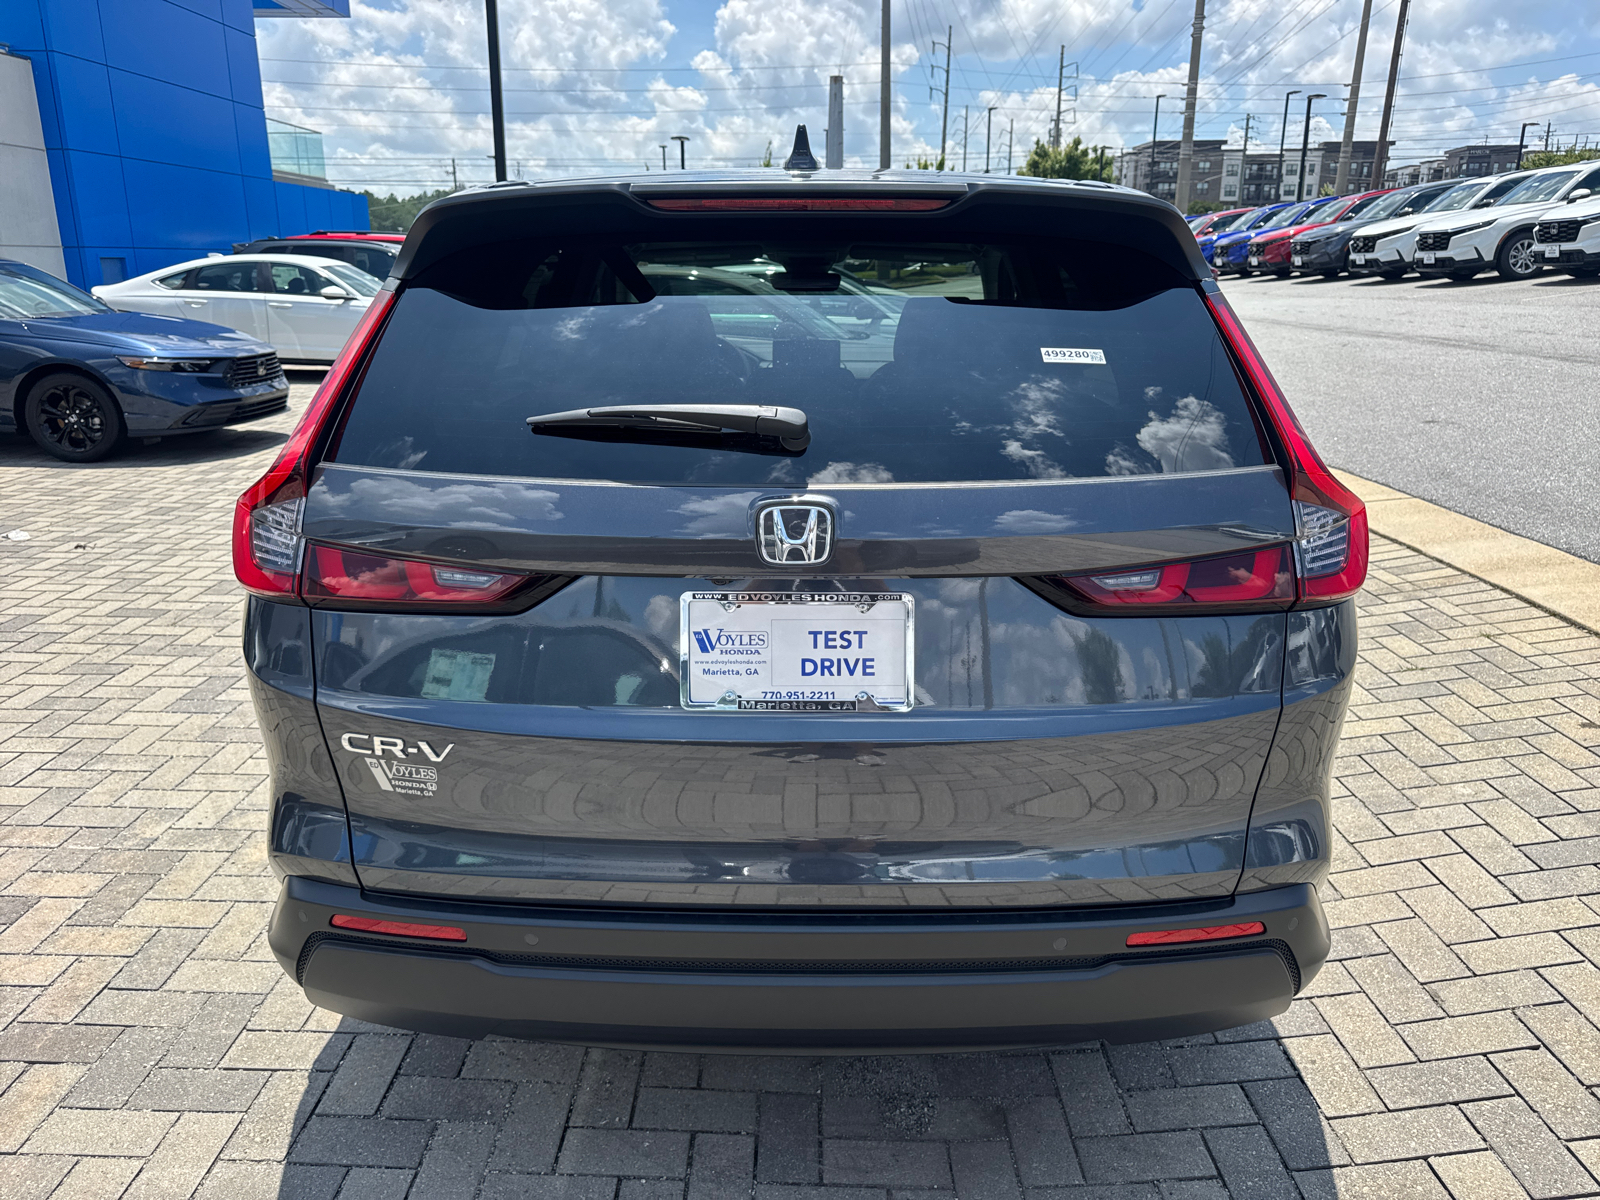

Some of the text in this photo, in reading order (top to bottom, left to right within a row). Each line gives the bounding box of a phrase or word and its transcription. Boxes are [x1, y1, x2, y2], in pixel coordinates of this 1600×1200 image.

[1044, 350, 1089, 358] 499280
[702, 628, 766, 651] VOYLES
[808, 630, 868, 650] TEST
[702, 668, 759, 677] Marietta, GA
[801, 658, 876, 677] DRIVE
[761, 691, 836, 700] 770-951-2211
[740, 700, 854, 711] Marietta, GA
[341, 732, 455, 762] CR-V
[379, 759, 436, 779] VOYLES
[391, 780, 426, 788] HONDA
[395, 787, 423, 797] Marietta,
